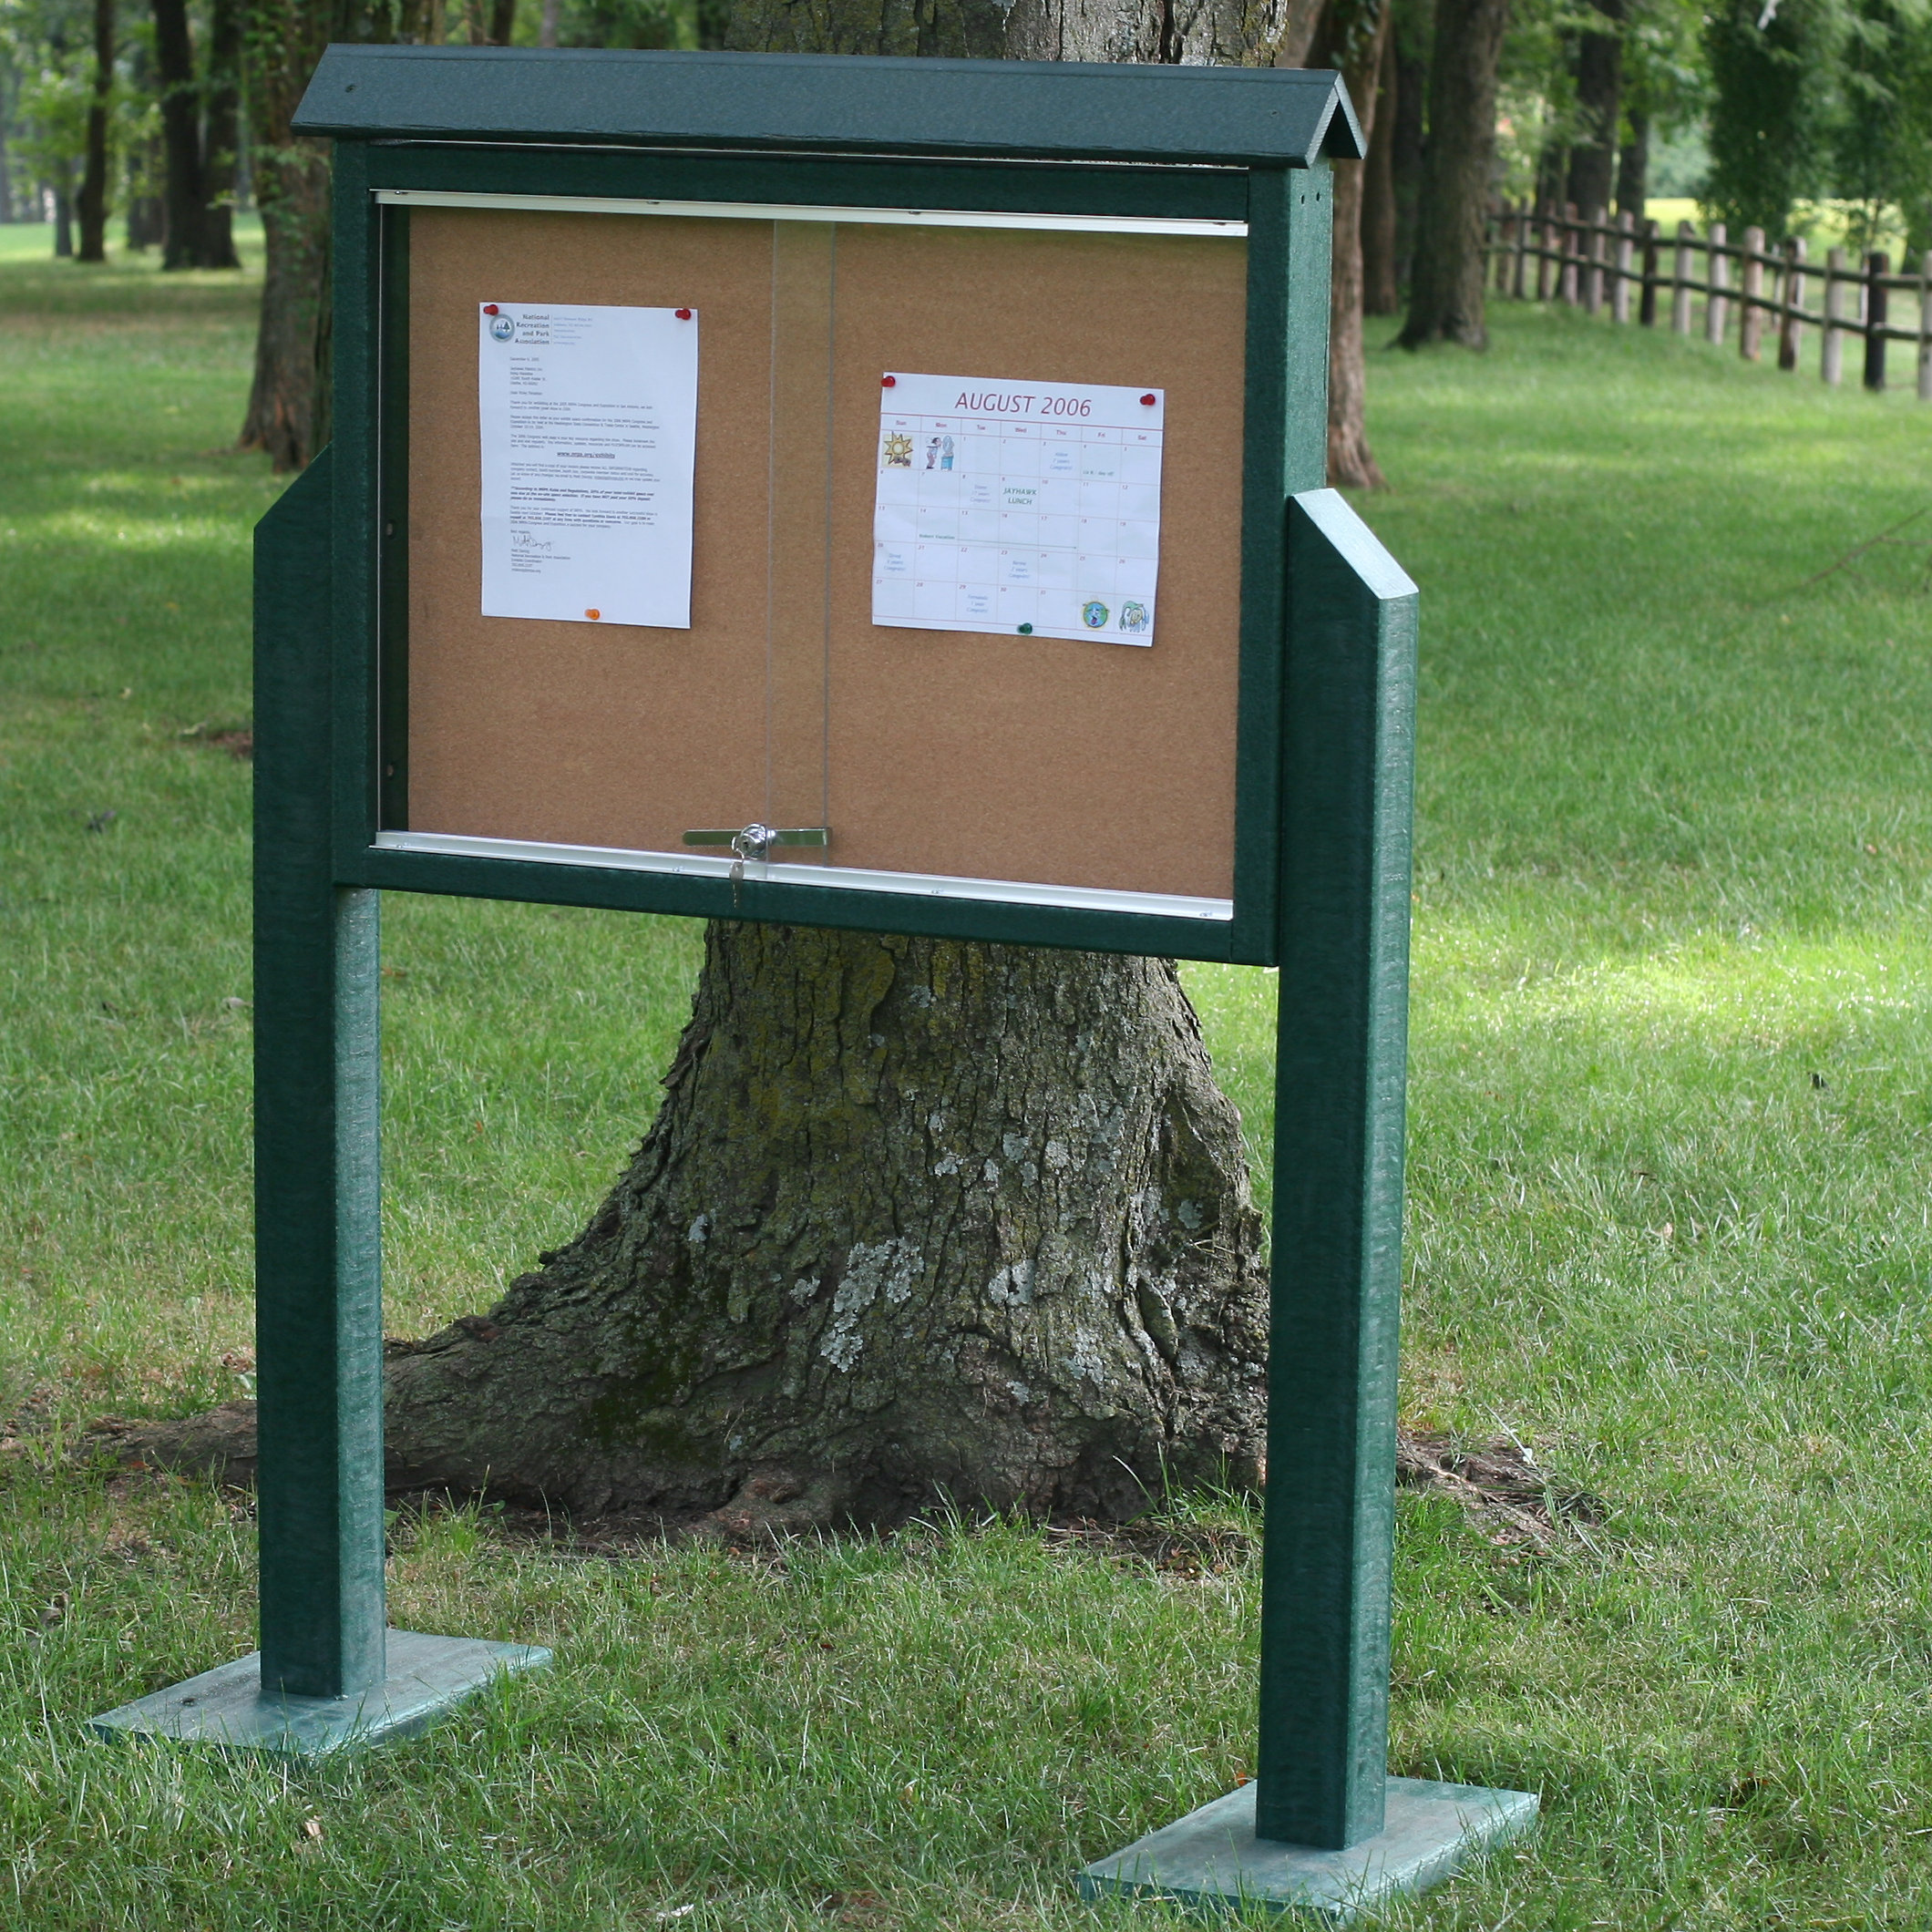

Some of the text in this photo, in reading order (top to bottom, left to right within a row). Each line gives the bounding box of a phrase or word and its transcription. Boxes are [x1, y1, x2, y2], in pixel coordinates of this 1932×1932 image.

[955, 393, 1092, 416] AUGUST 2006
[1003, 487, 1037, 496] JAYHAWK
[1008, 497, 1033, 505] LUNCH
